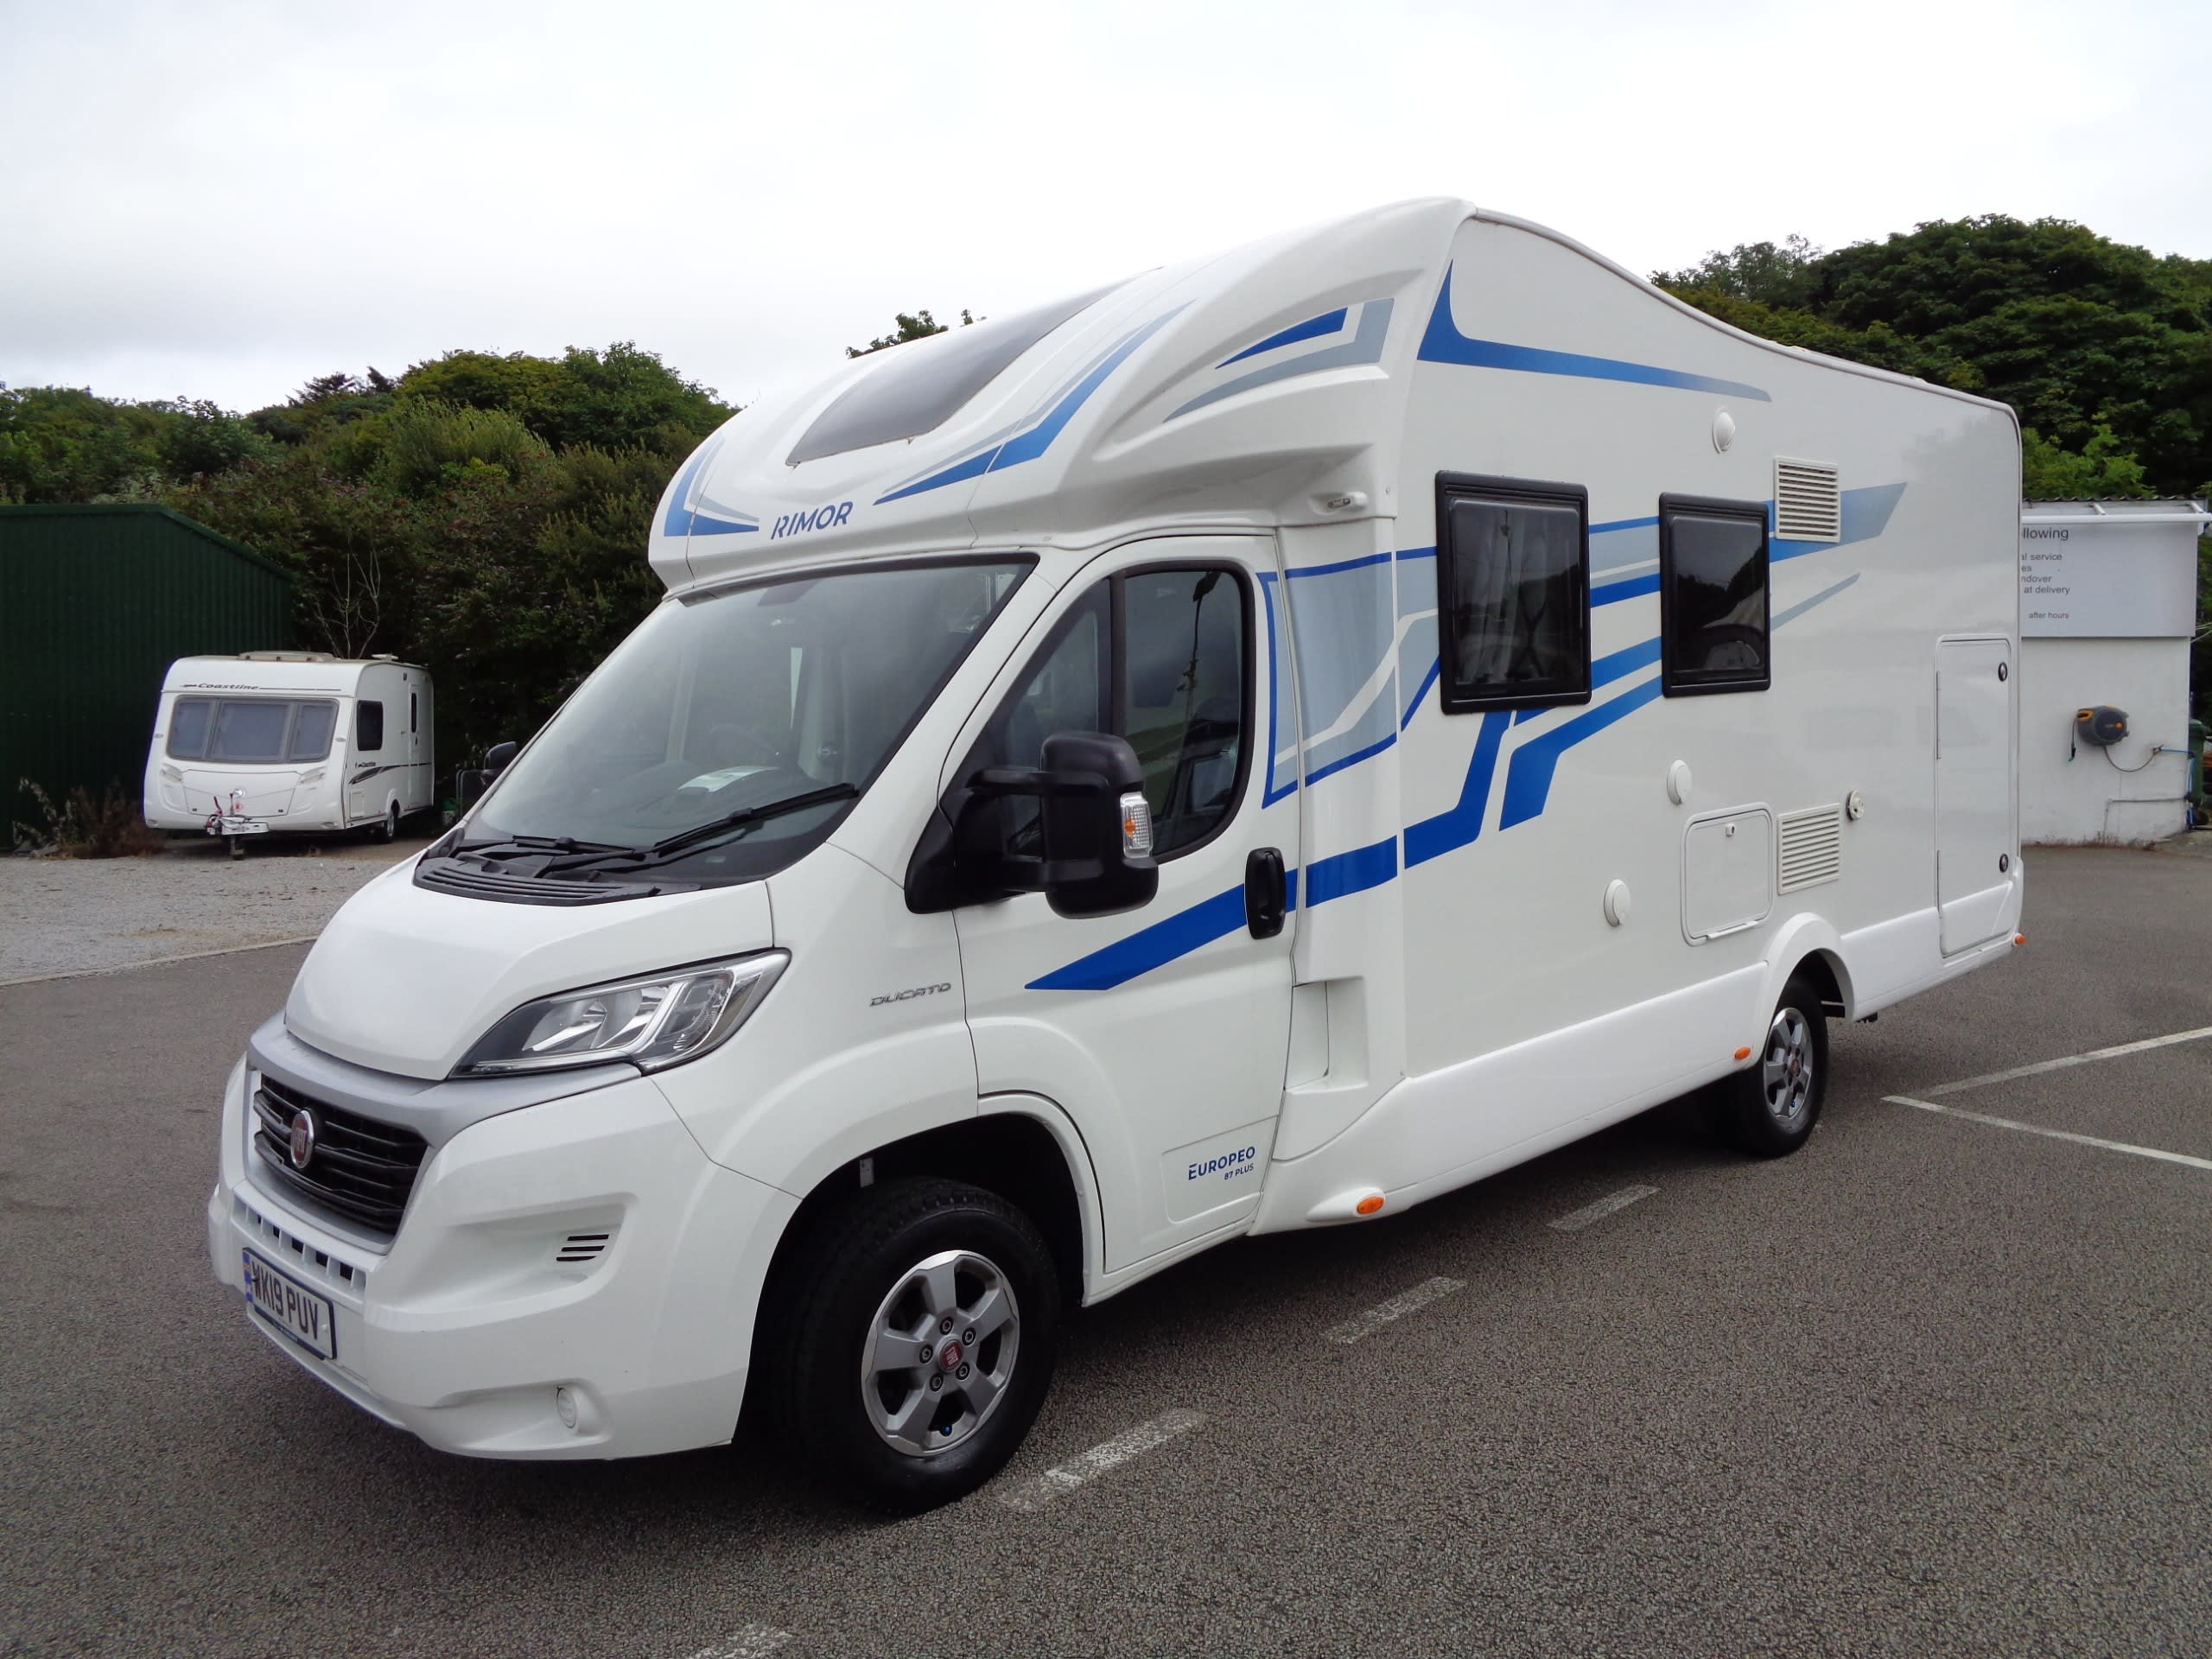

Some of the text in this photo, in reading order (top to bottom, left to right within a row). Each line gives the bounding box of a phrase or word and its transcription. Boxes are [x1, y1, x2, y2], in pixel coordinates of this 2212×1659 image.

[771, 501, 854, 540] RIMOR
[2035, 586, 2070, 594] delivery
[869, 982, 952, 1007] DUCATO
[1188, 1146, 1255, 1180] EUROPEO
[1235, 1163, 1255, 1177] PLUS
[285, 1285, 319, 1341] PUV
